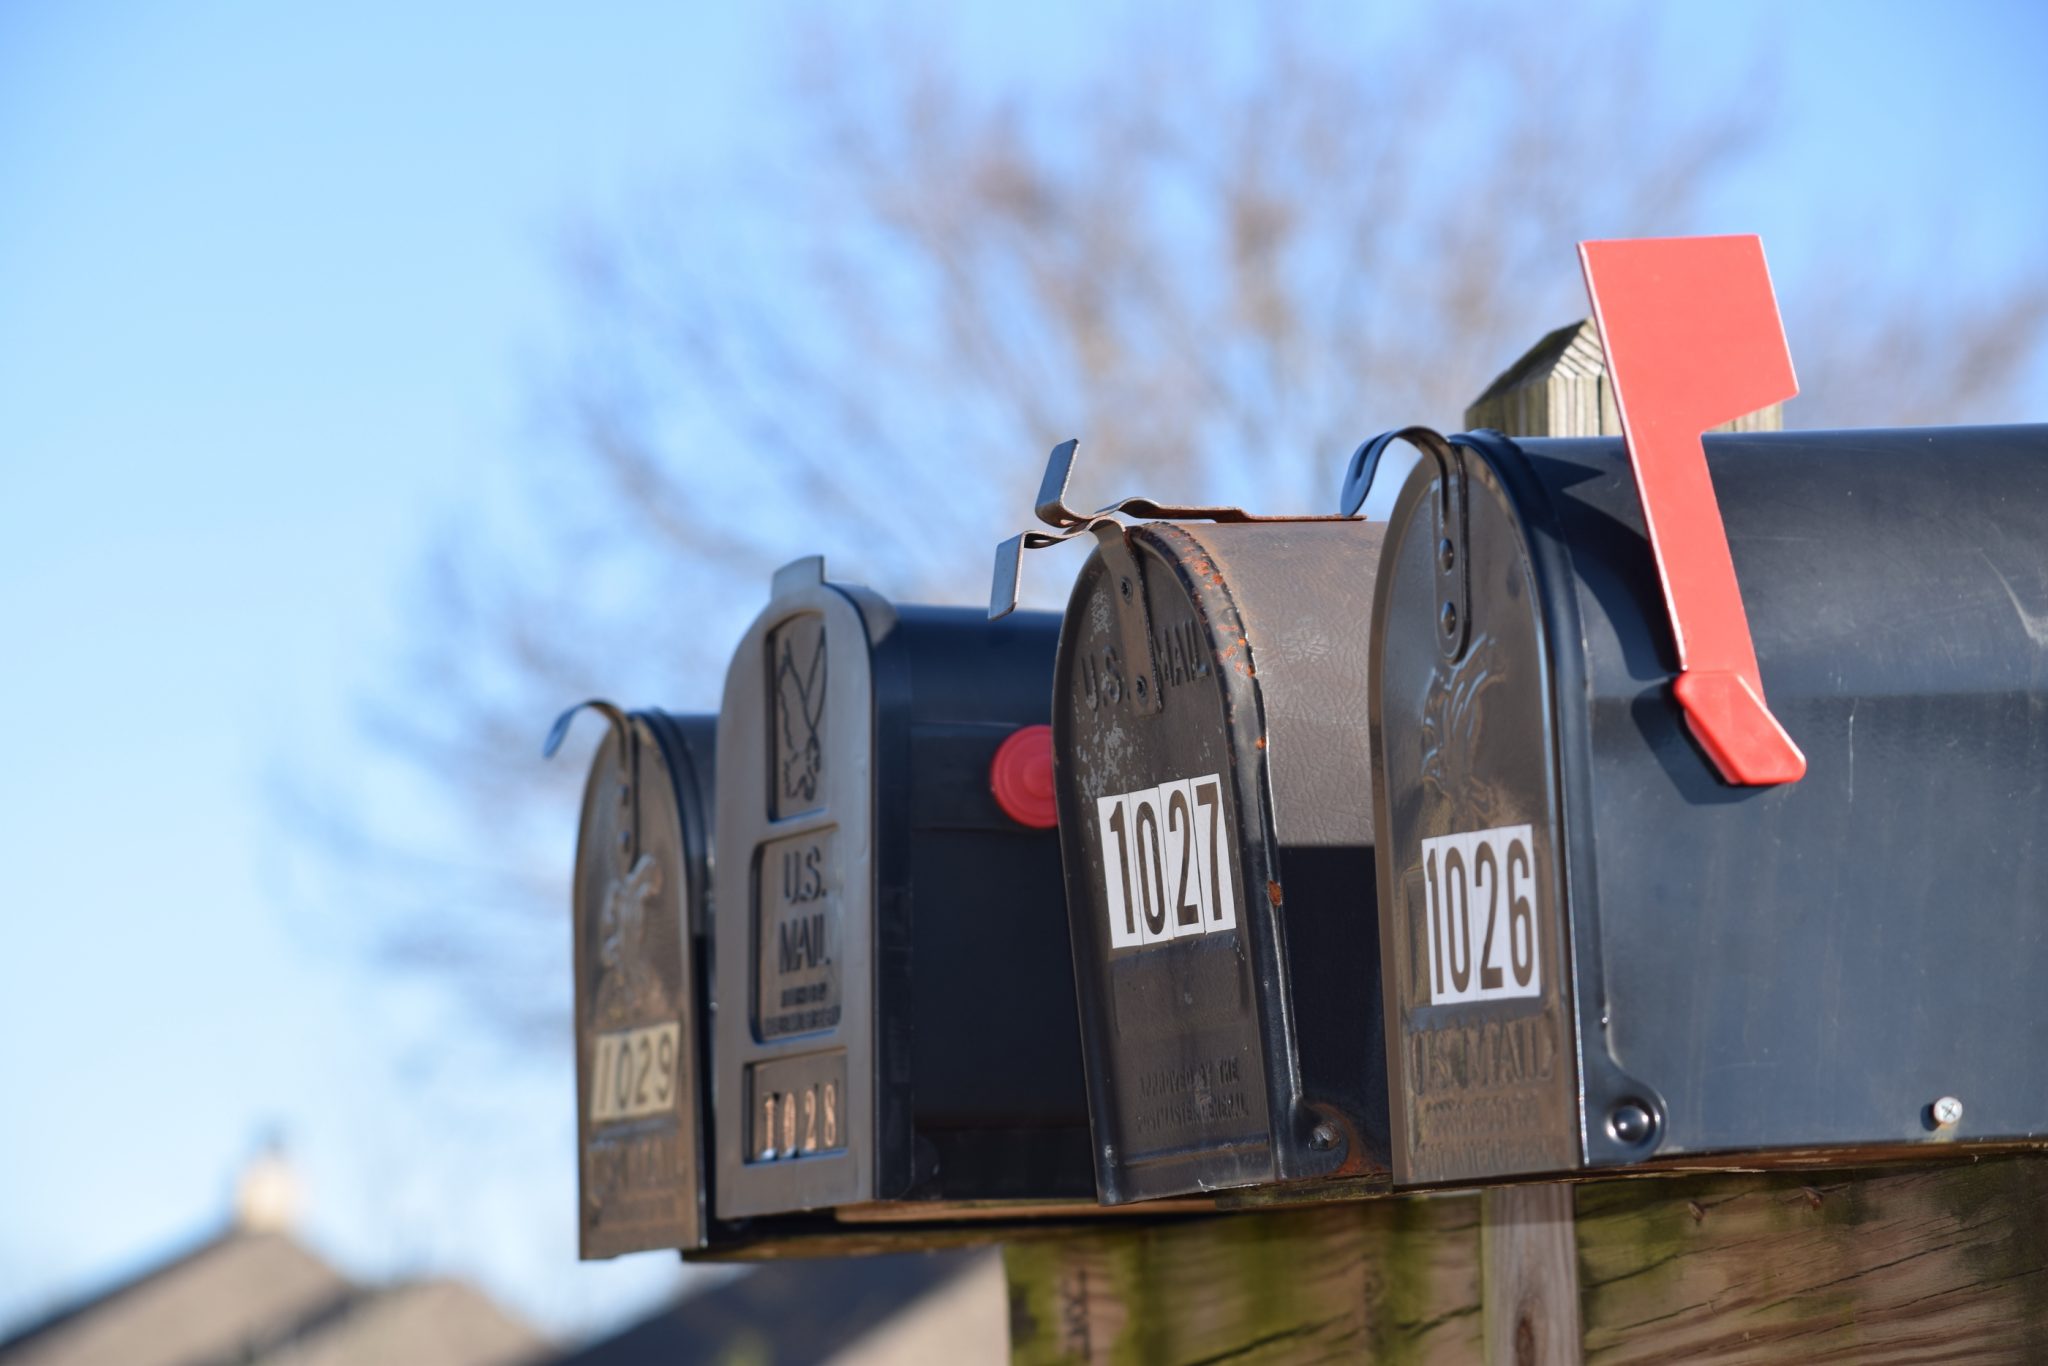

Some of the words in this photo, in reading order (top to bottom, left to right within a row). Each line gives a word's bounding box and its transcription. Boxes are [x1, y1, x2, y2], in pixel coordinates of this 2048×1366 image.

[1151, 619, 1210, 690] MAIL
[1109, 781, 1223, 936] 1027
[1425, 838, 1534, 994] 1026
[598, 1031, 674, 1114] 1029
[764, 1083, 836, 1152] 1028
